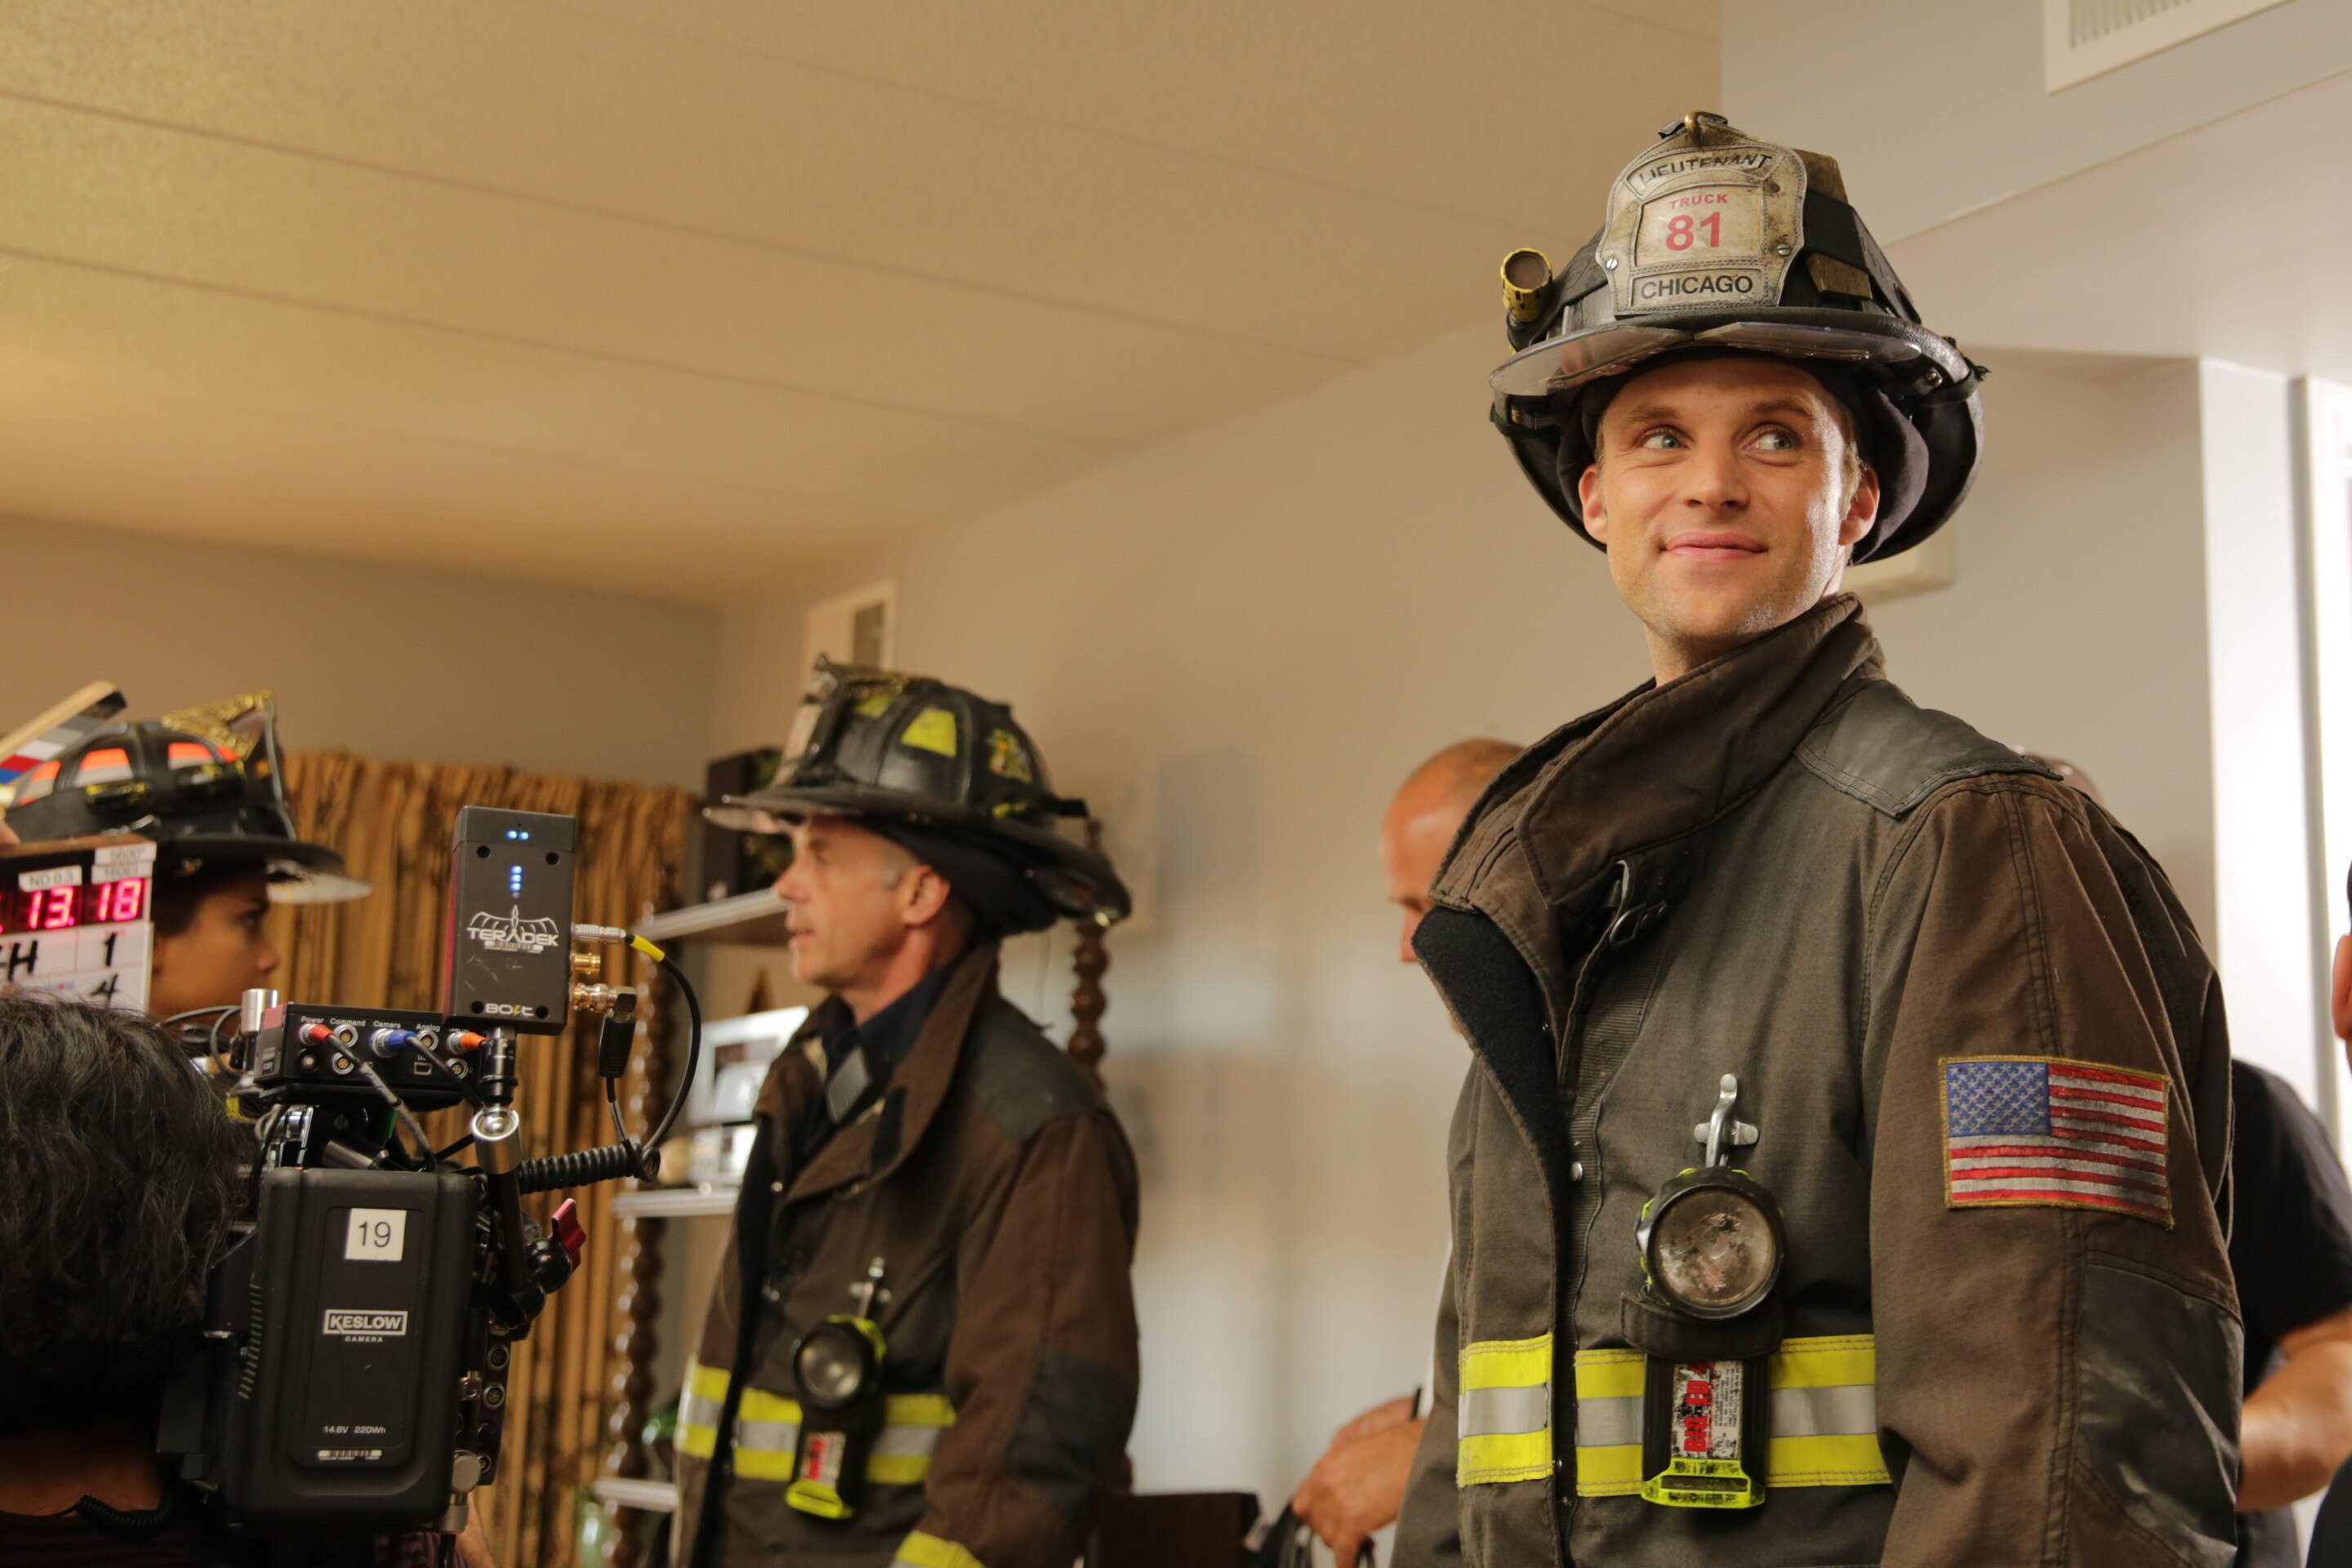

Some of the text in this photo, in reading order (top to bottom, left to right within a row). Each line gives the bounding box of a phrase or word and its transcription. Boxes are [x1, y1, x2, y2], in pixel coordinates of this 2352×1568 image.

[1638, 154, 1773, 186] LIEUTENANT
[1669, 193, 1729, 210] TRUCK
[1665, 212, 1722, 252] 81
[1641, 275, 1753, 300] CHICAGO
[466, 927, 559, 947] TERADEK
[330, 1018, 366, 1027] Command
[416, 1023, 440, 1032] Analog
[358, 1222, 392, 1248] 19
[330, 1315, 402, 1332] KESLOW
[354, 1425, 386, 1434] 220Wh
[1684, 1416, 1708, 1452] BIG
